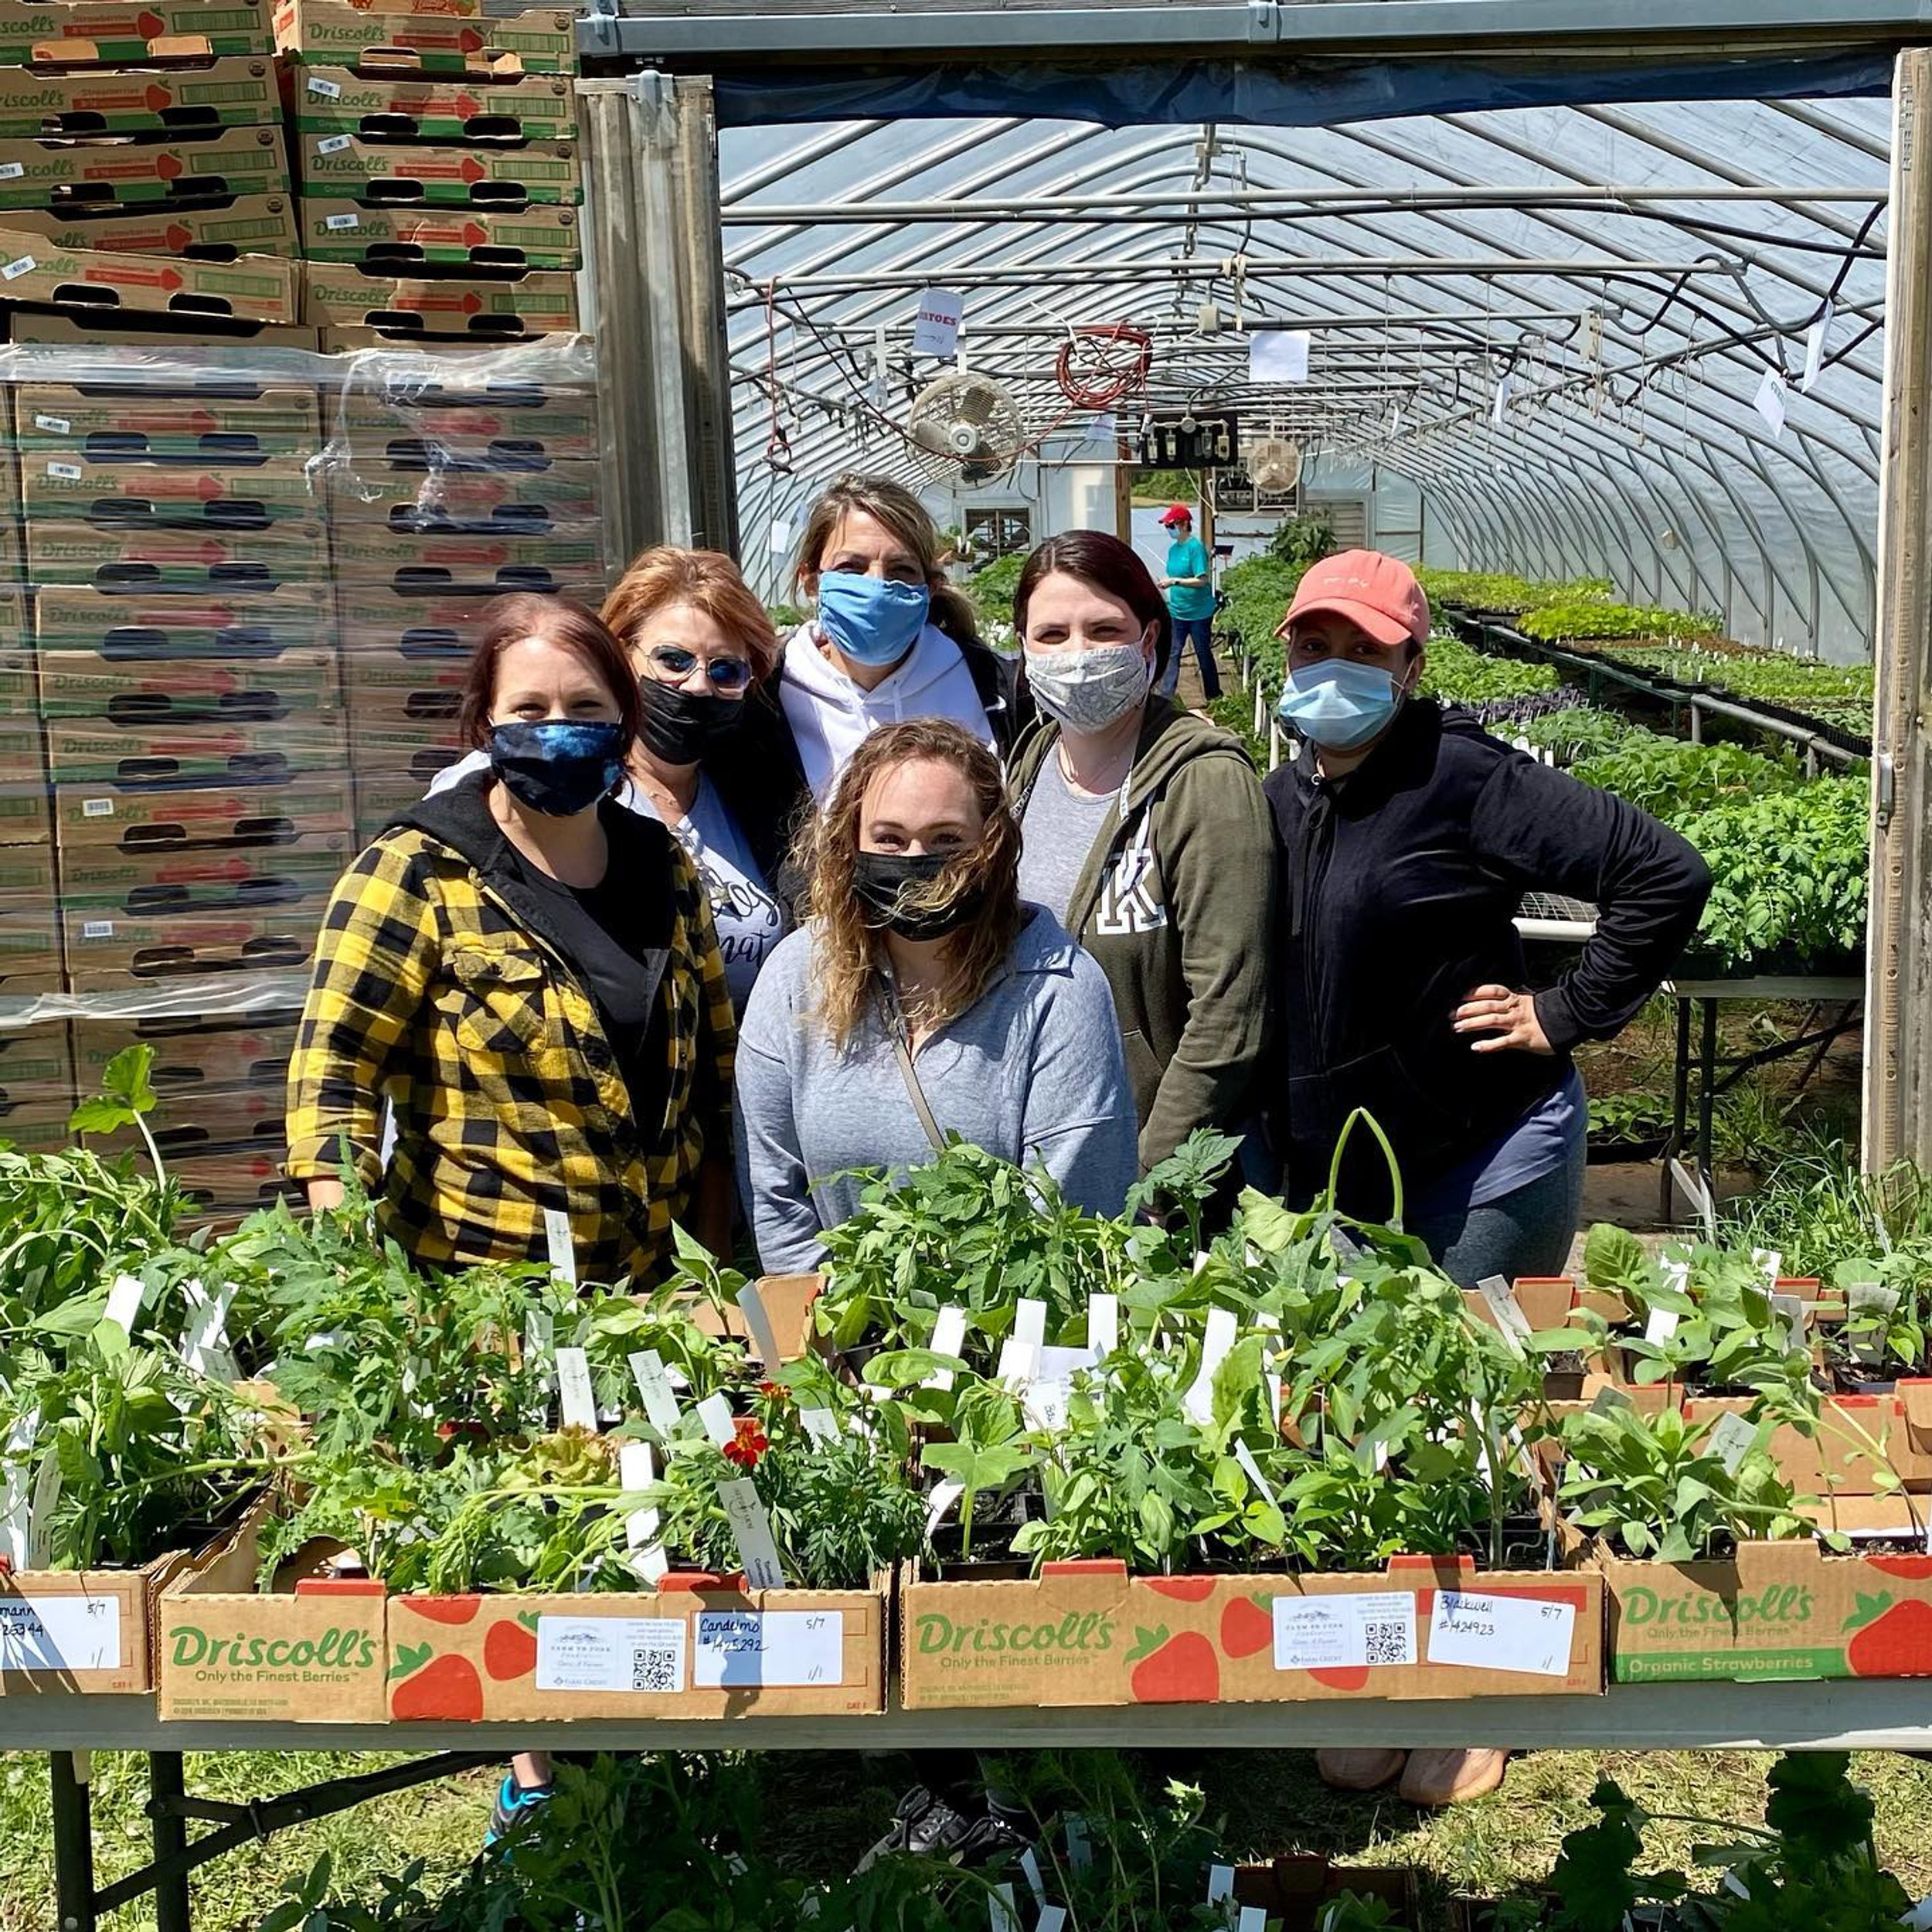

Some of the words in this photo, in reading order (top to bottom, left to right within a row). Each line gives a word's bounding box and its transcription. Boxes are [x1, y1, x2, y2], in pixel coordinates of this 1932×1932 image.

[308, 23, 386, 41] Driscoll's
[311, 155, 387, 172] Driscoll's
[87, 1599, 106, 1618] 5/7
[1540, 1604, 1563, 1621] 5/7
[1621, 1584, 1815, 1625] Driscoll's
[806, 1617, 825, 1630] 5/7
[916, 1611, 1115, 1654] Driscoll's
[168, 1626, 377, 1667] Driscoll's
[940, 1657, 971, 1670] Only
[975, 1656, 996, 1667] the
[999, 1655, 1039, 1666] Finest
[1043, 1654, 1090, 1665] Berries
[1630, 1659, 1696, 1675] Organic
[1702, 1655, 1814, 1672] Strawberries
[195, 1669, 227, 1684] Only
[231, 1670, 253, 1682] the
[256, 1669, 300, 1682] Finest
[302, 1669, 350, 1682] Berries
